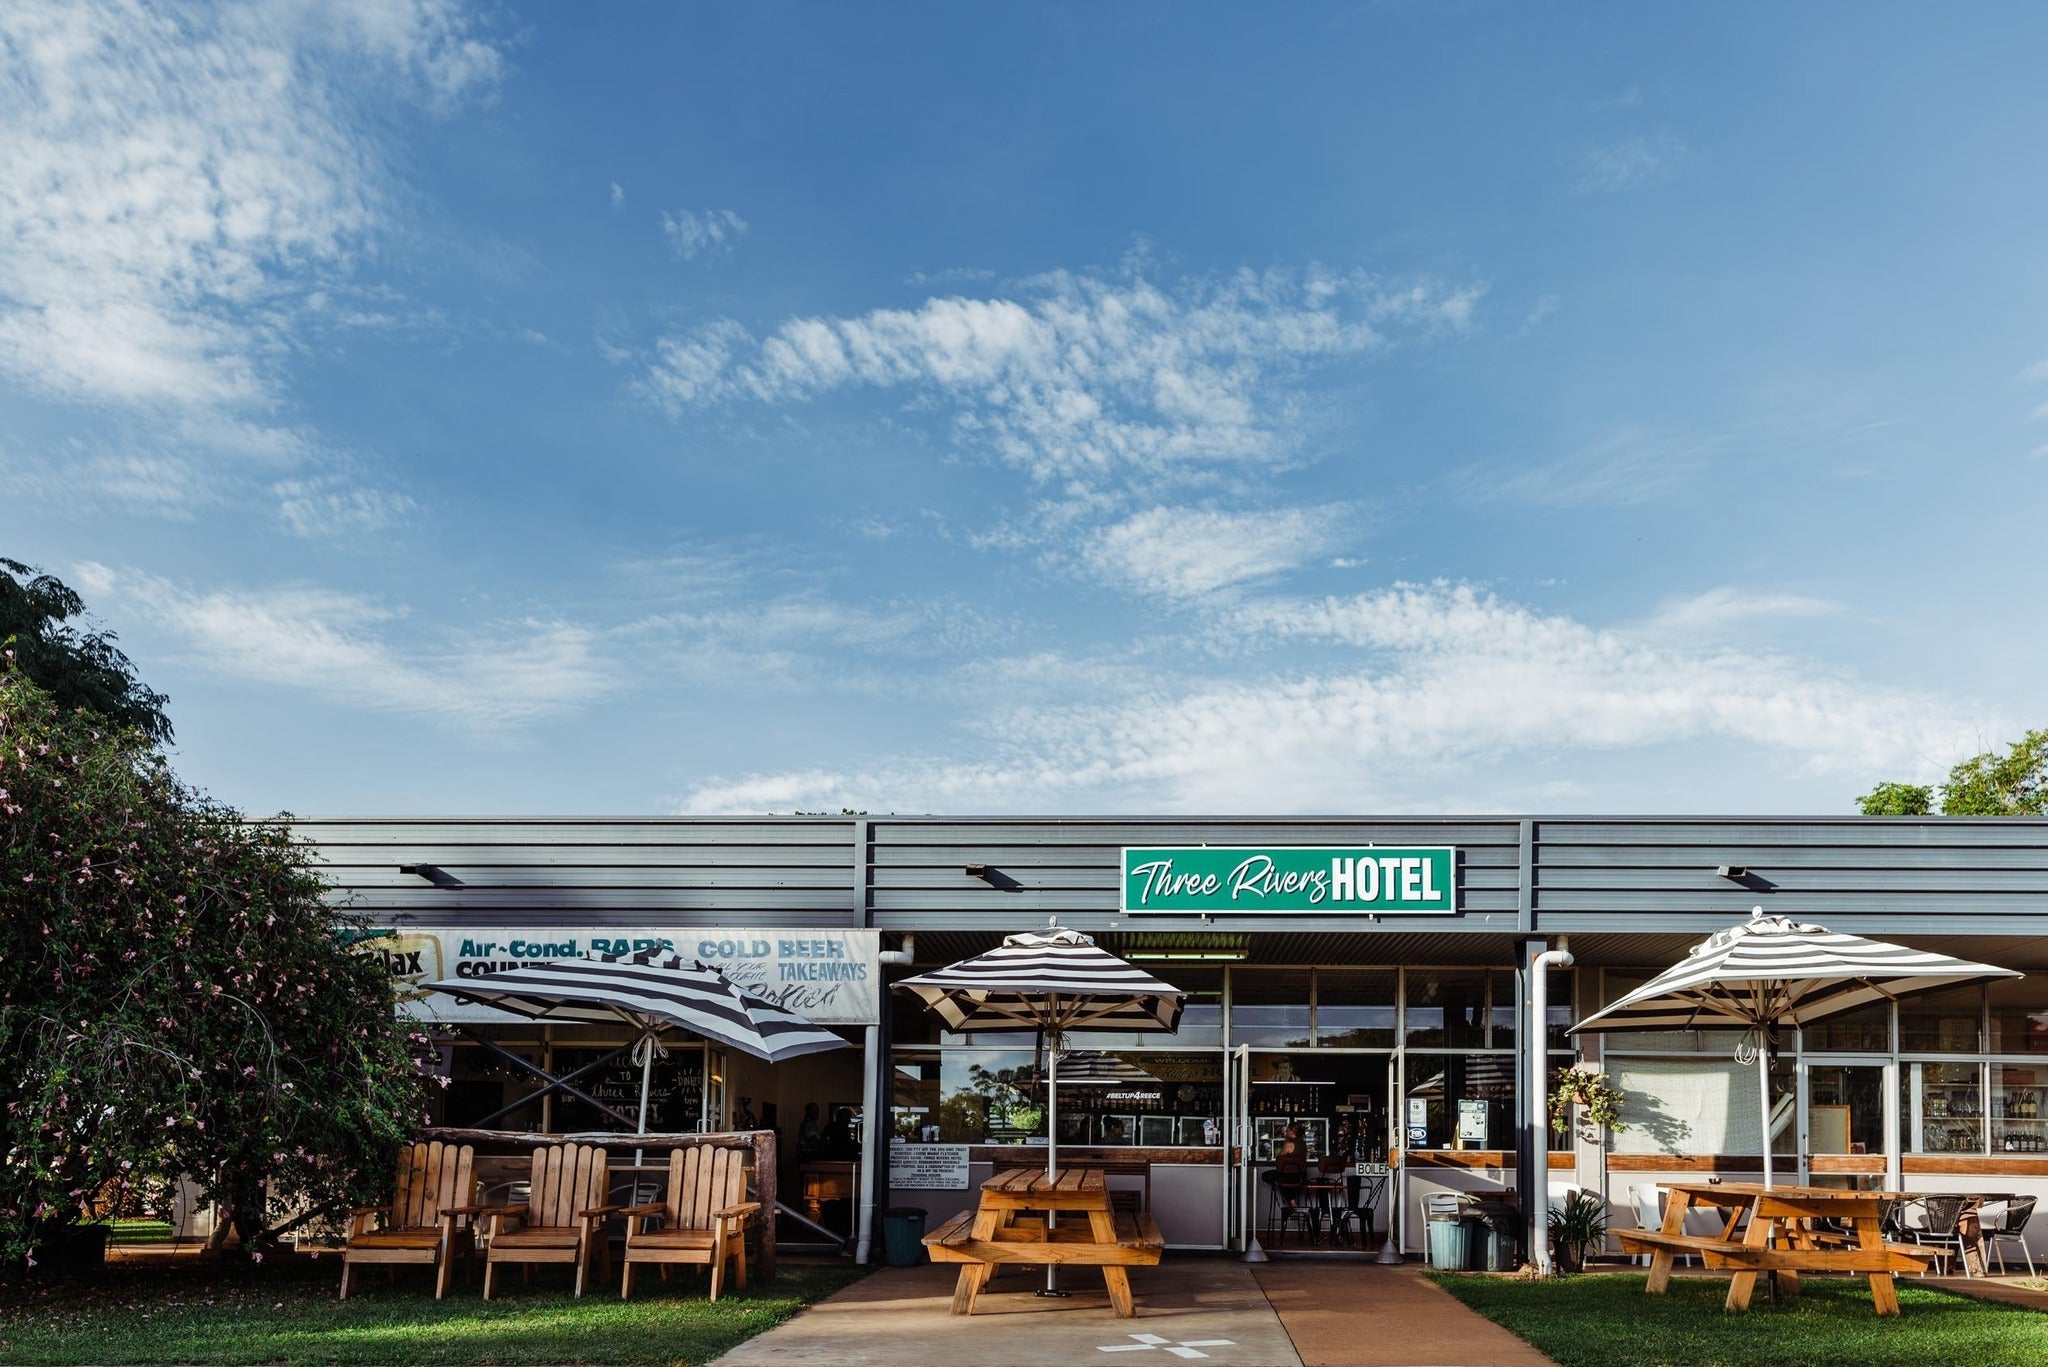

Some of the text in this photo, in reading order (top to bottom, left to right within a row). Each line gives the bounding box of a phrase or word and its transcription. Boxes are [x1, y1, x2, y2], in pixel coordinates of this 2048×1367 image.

[1131, 854, 1442, 905] Three Rivers HOTEL
[698, 939, 844, 959] COLD BEER
[778, 962, 868, 981] TAKEAWAYS
[1105, 1091, 1162, 1100] #BELTUP4REECE
